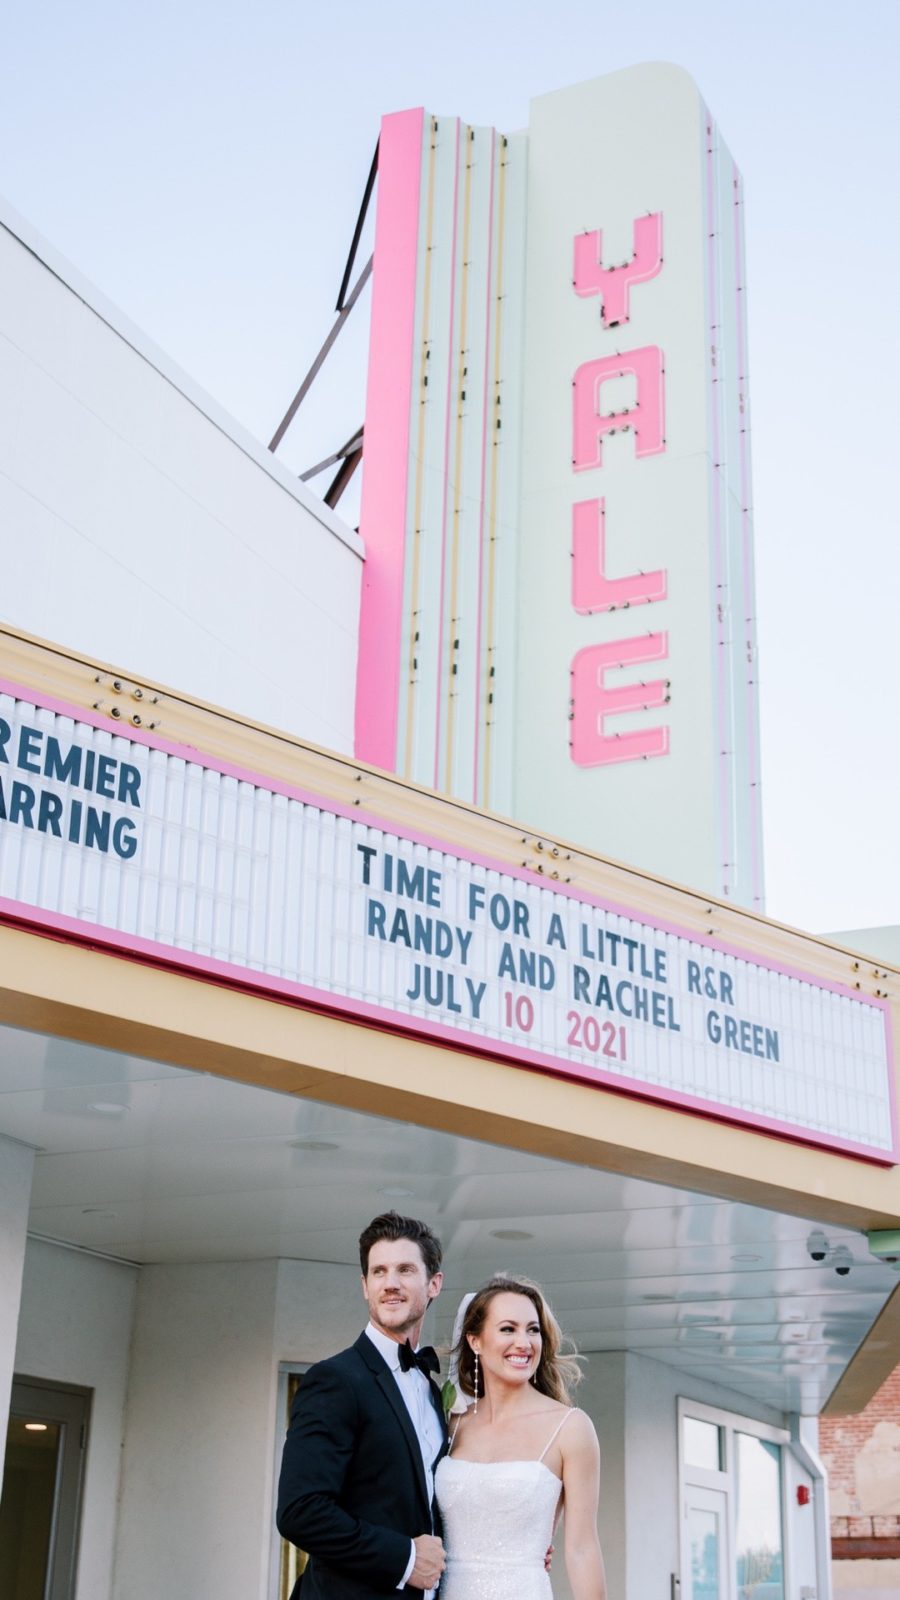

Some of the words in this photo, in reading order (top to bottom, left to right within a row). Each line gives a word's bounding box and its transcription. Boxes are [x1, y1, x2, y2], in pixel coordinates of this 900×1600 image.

[569, 210, 669, 768] YALE
[0, 775, 138, 859] RRING
[357, 843, 442, 908] TIME
[469, 882, 531, 939] FOR
[546, 912, 567, 950] A
[581, 922, 668, 984] LITTLE
[687, 959, 735, 1006] R&R
[367, 898, 473, 966] RANDY
[498, 942, 556, 991] AND
[573, 963, 681, 1032] RACHEL
[706, 1009, 780, 1063] GREEN
[406, 963, 487, 1019] JULY
[504, 991, 535, 1033] 10
[566, 1010, 627, 1061] 2021
